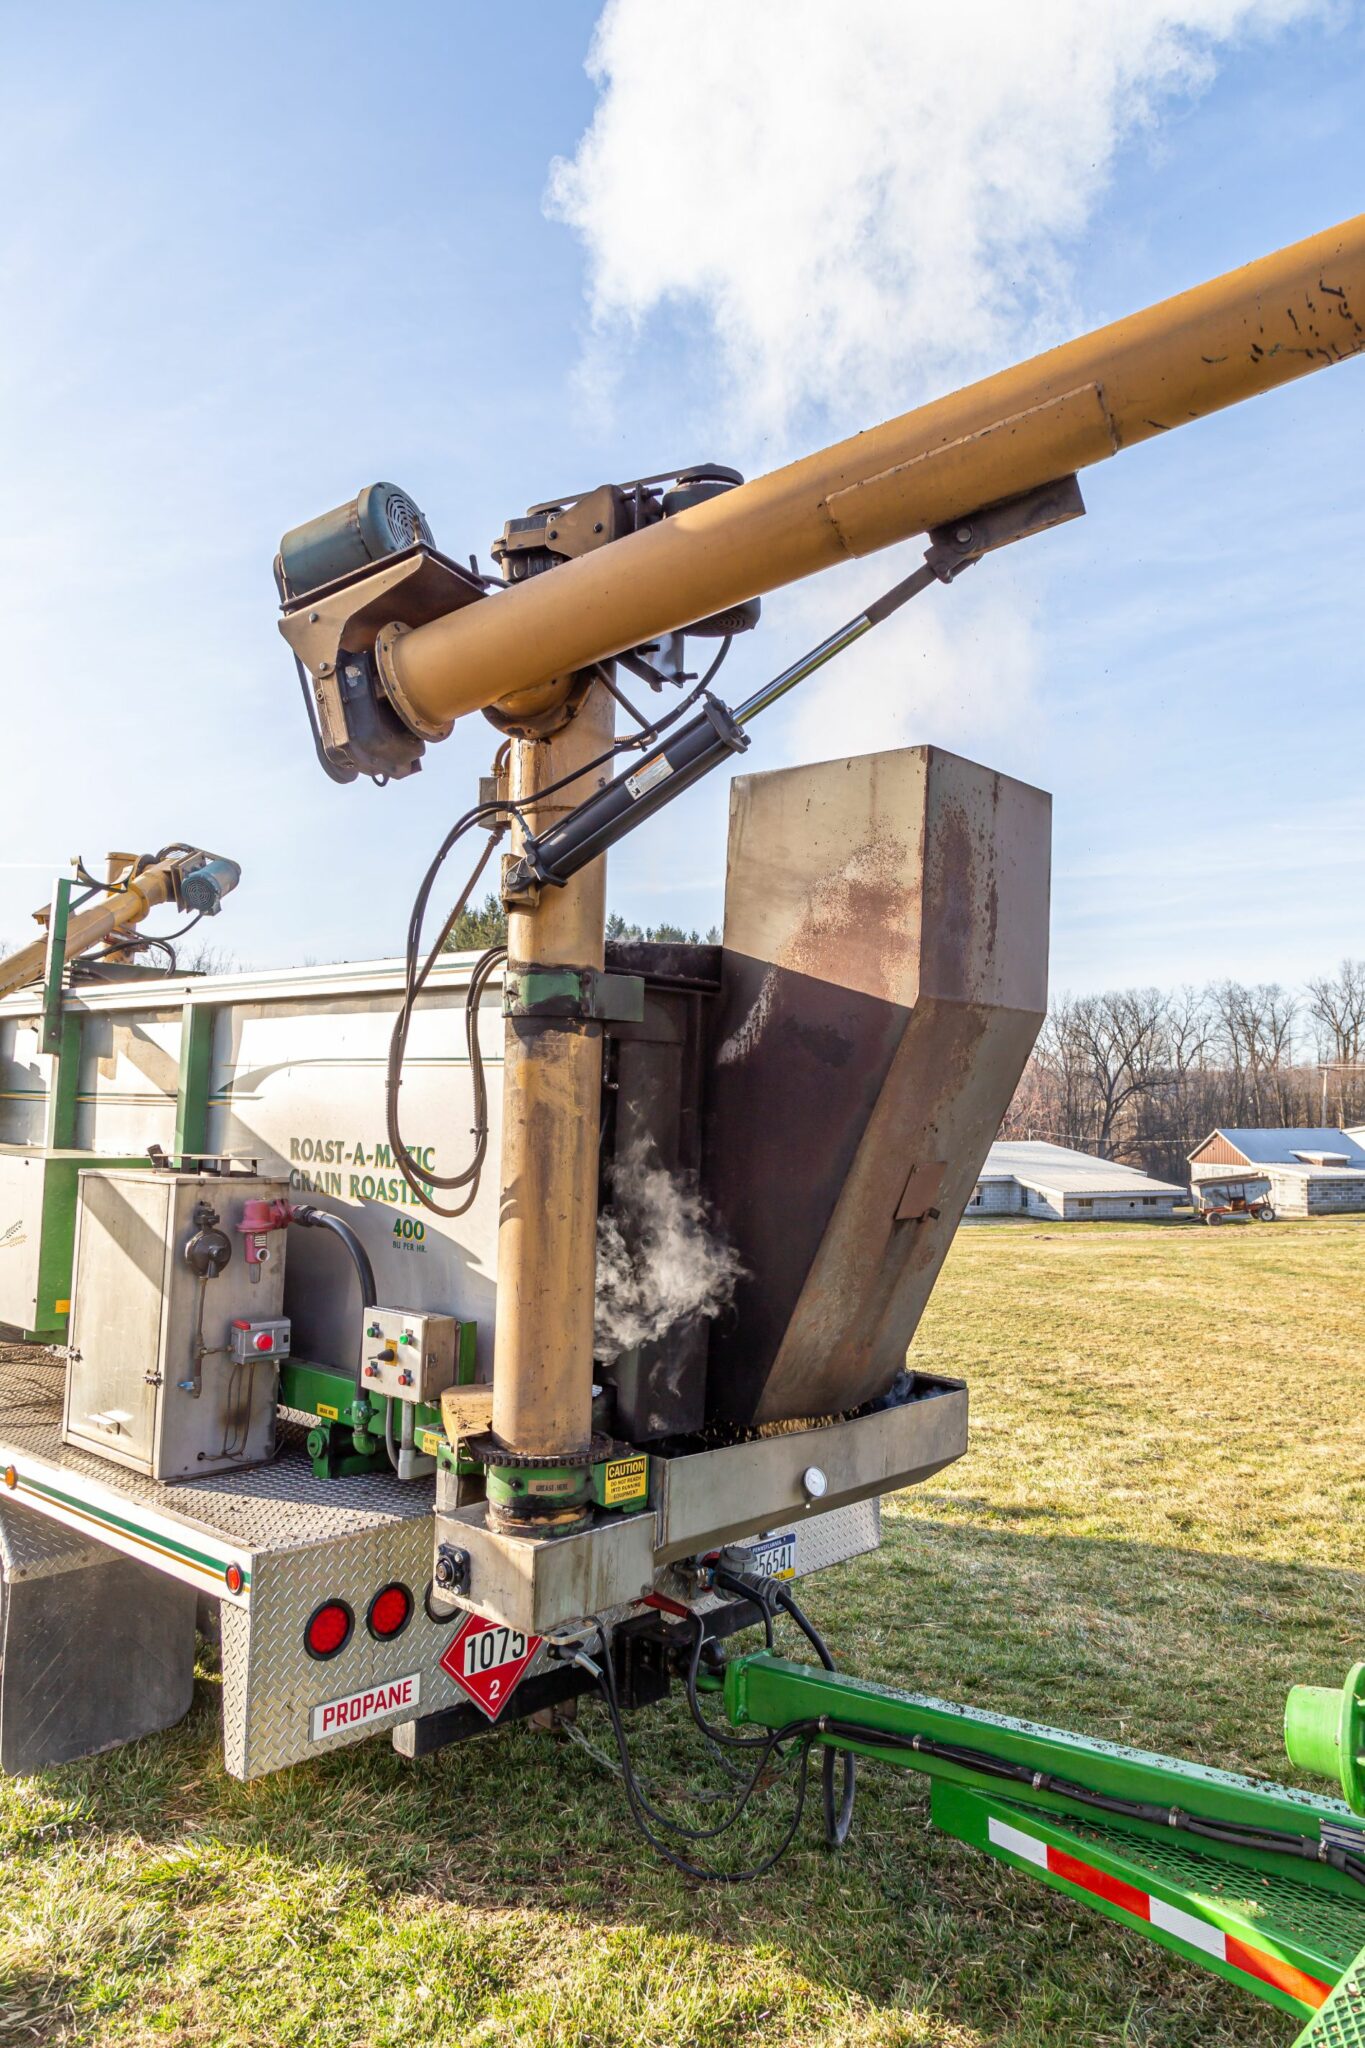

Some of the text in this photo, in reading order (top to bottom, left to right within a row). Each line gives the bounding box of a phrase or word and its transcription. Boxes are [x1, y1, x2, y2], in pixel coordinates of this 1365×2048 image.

[290, 1138, 435, 1171] ROAST-A-MTIC
[290, 1168, 341, 1195] GRAIN
[393, 1218, 426, 1241] 400
[403, 1241, 414, 1251] PER
[608, 1460, 644, 1478] CAUTION
[627, 1475, 642, 1483] REACH
[613, 1488, 639, 1500] EQUIPMENT
[621, 1481, 641, 1491] RUNNING
[752, 1539, 783, 1554] PENNSYLVANIA
[753, 1544, 792, 1577] 56541
[467, 1627, 525, 1674] 1075
[489, 1679, 501, 1700] 2
[322, 1679, 413, 1732] PROPANE
